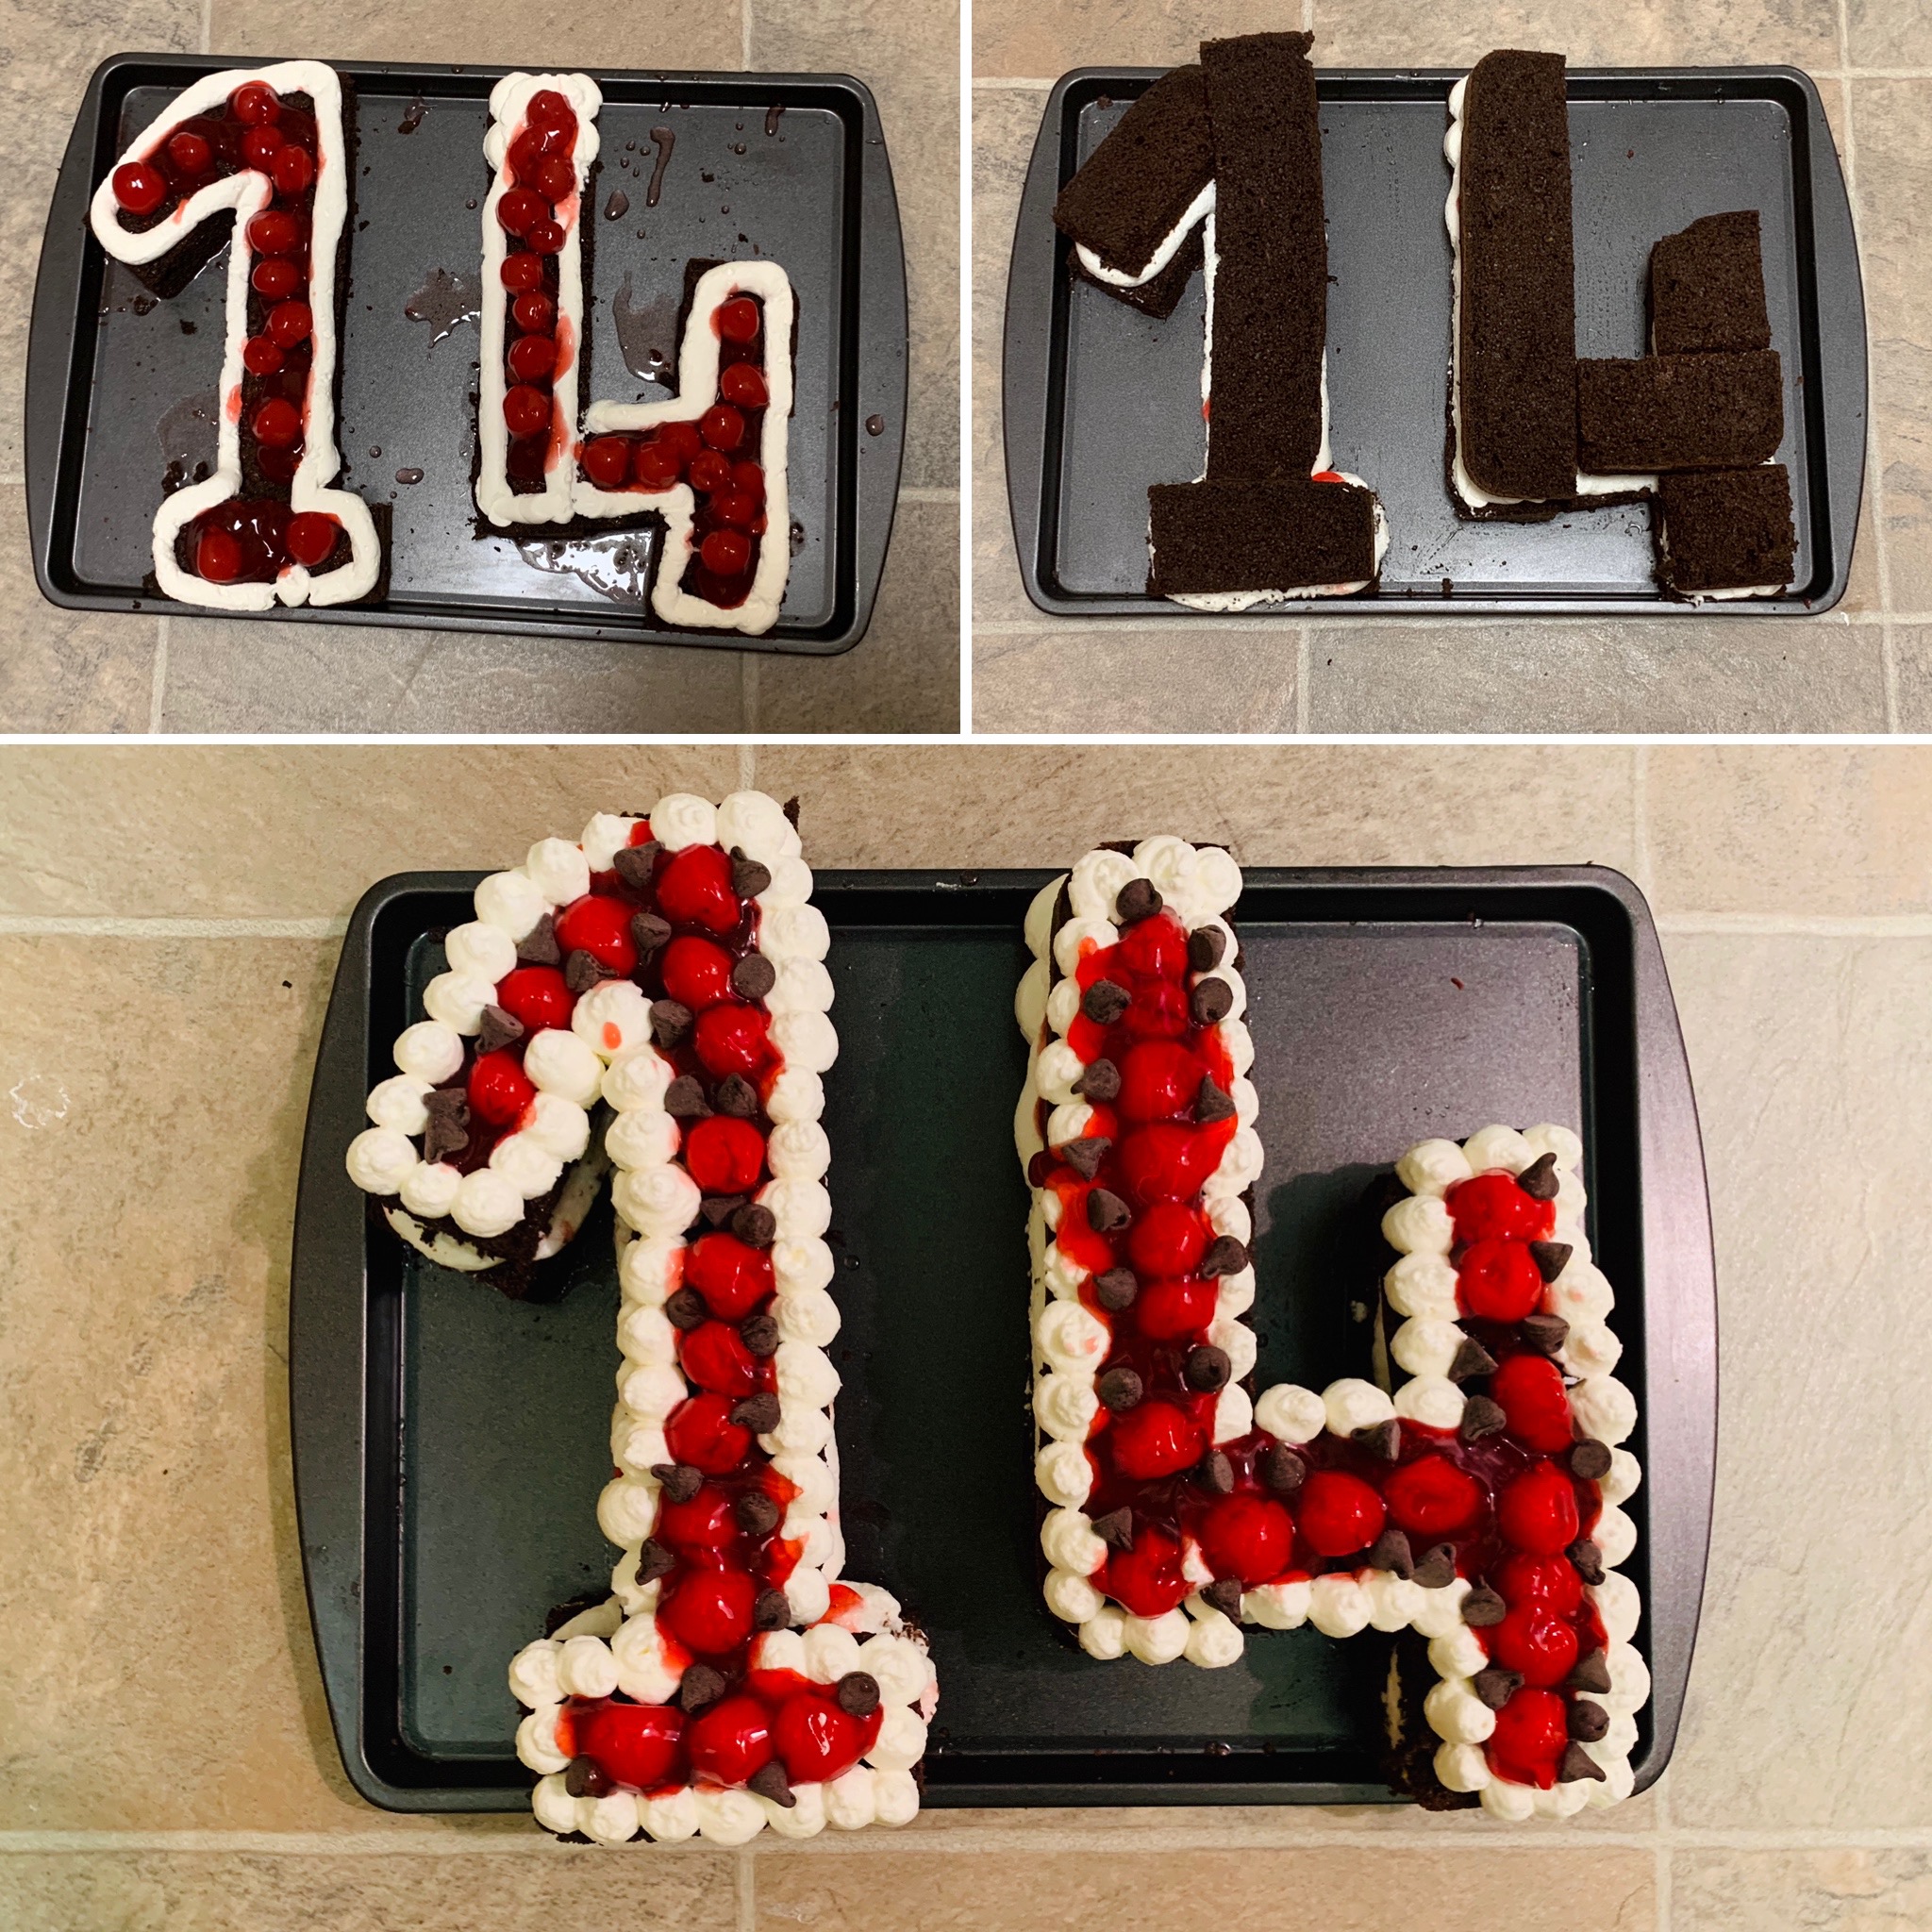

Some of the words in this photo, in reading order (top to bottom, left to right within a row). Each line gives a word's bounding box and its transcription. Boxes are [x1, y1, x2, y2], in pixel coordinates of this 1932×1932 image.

[87, 60, 802, 634] 14
[1055, 31, 1794, 611] 14
[345, 790, 1649, 1845] 14
